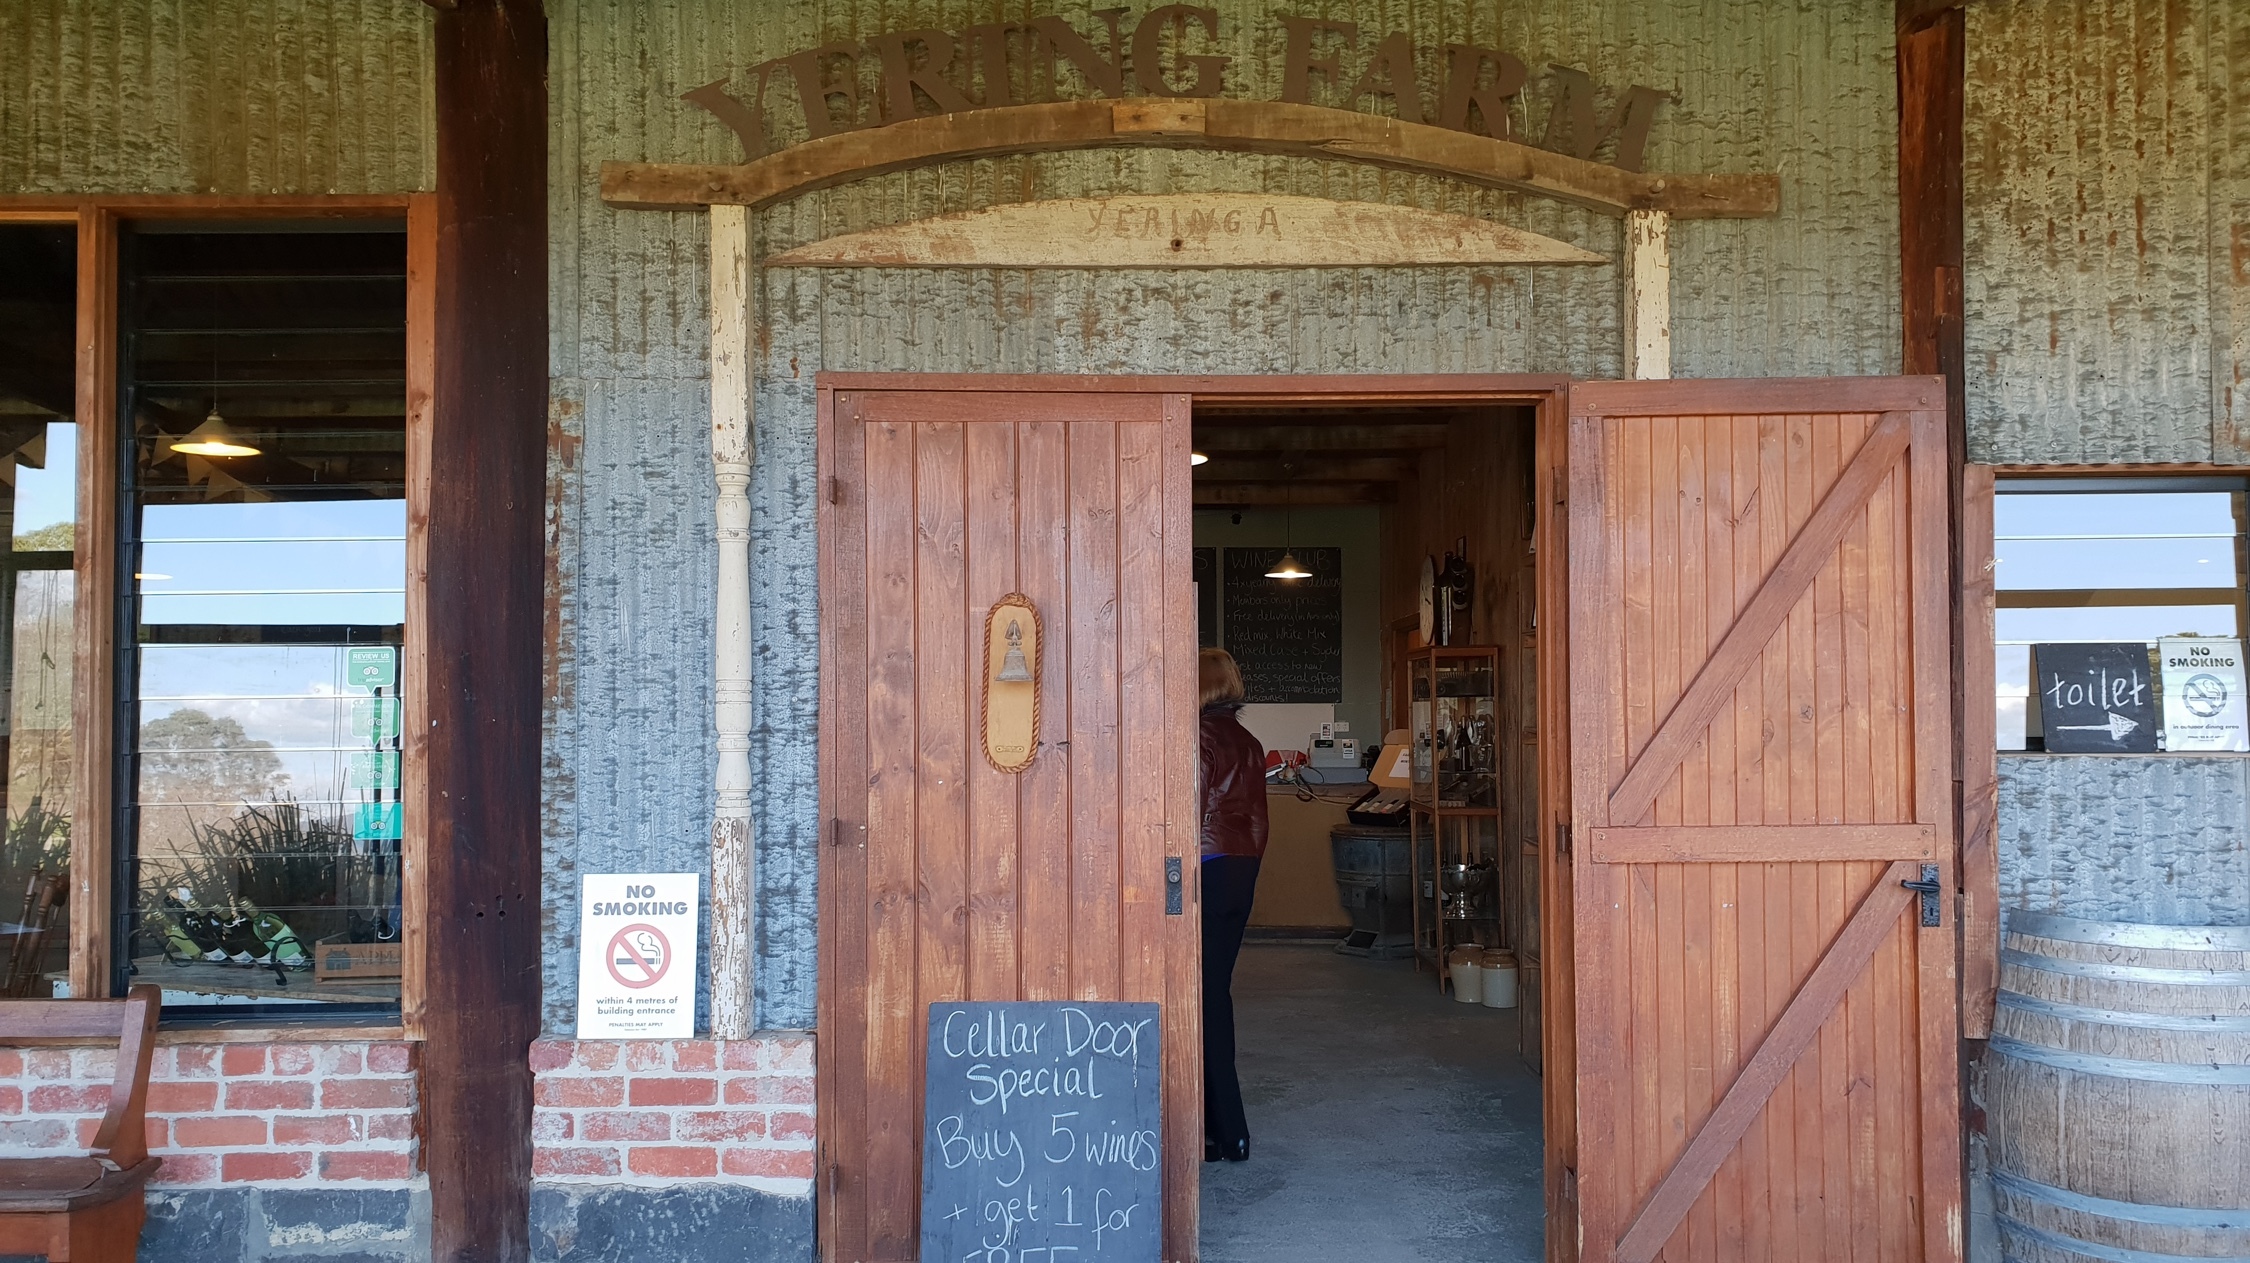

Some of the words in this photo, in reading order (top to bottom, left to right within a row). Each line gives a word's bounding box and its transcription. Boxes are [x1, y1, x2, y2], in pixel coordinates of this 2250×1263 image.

[682, 3, 1231, 161] YERING
[1277, 9, 1681, 171] FARM
[1231, 549, 1276, 568] WINE
[1291, 549, 1330, 570] LUB
[1233, 609, 1253, 621] Free
[1233, 625, 1251, 641] Red
[1233, 643, 1268, 656] Mixed
[2189, 646, 2211, 656] NO
[2169, 657, 2235, 668] SMOKING
[2046, 667, 2146, 710] toilet
[2205, 723, 2224, 731] dining
[626, 884, 656, 898] NO
[592, 901, 688, 916] SMOKING
[596, 996, 624, 1005] within
[669, 996, 679, 1004] of
[597, 1006, 634, 1016] building
[636, 1007, 676, 1015] entrance
[943, 1009, 1046, 1058] Cellar
[1059, 1007, 1152, 1060] Door
[966, 1056, 1103, 1115] Special
[936, 1114, 1025, 1187] Buy
[1044, 1111, 1079, 1163] 5
[1085, 1120, 1157, 1171] wines
[943, 1203, 968, 1220] +
[983, 1184, 1039, 1249] get
[1055, 1185, 1082, 1226] 1
[1092, 1188, 1140, 1251] for
